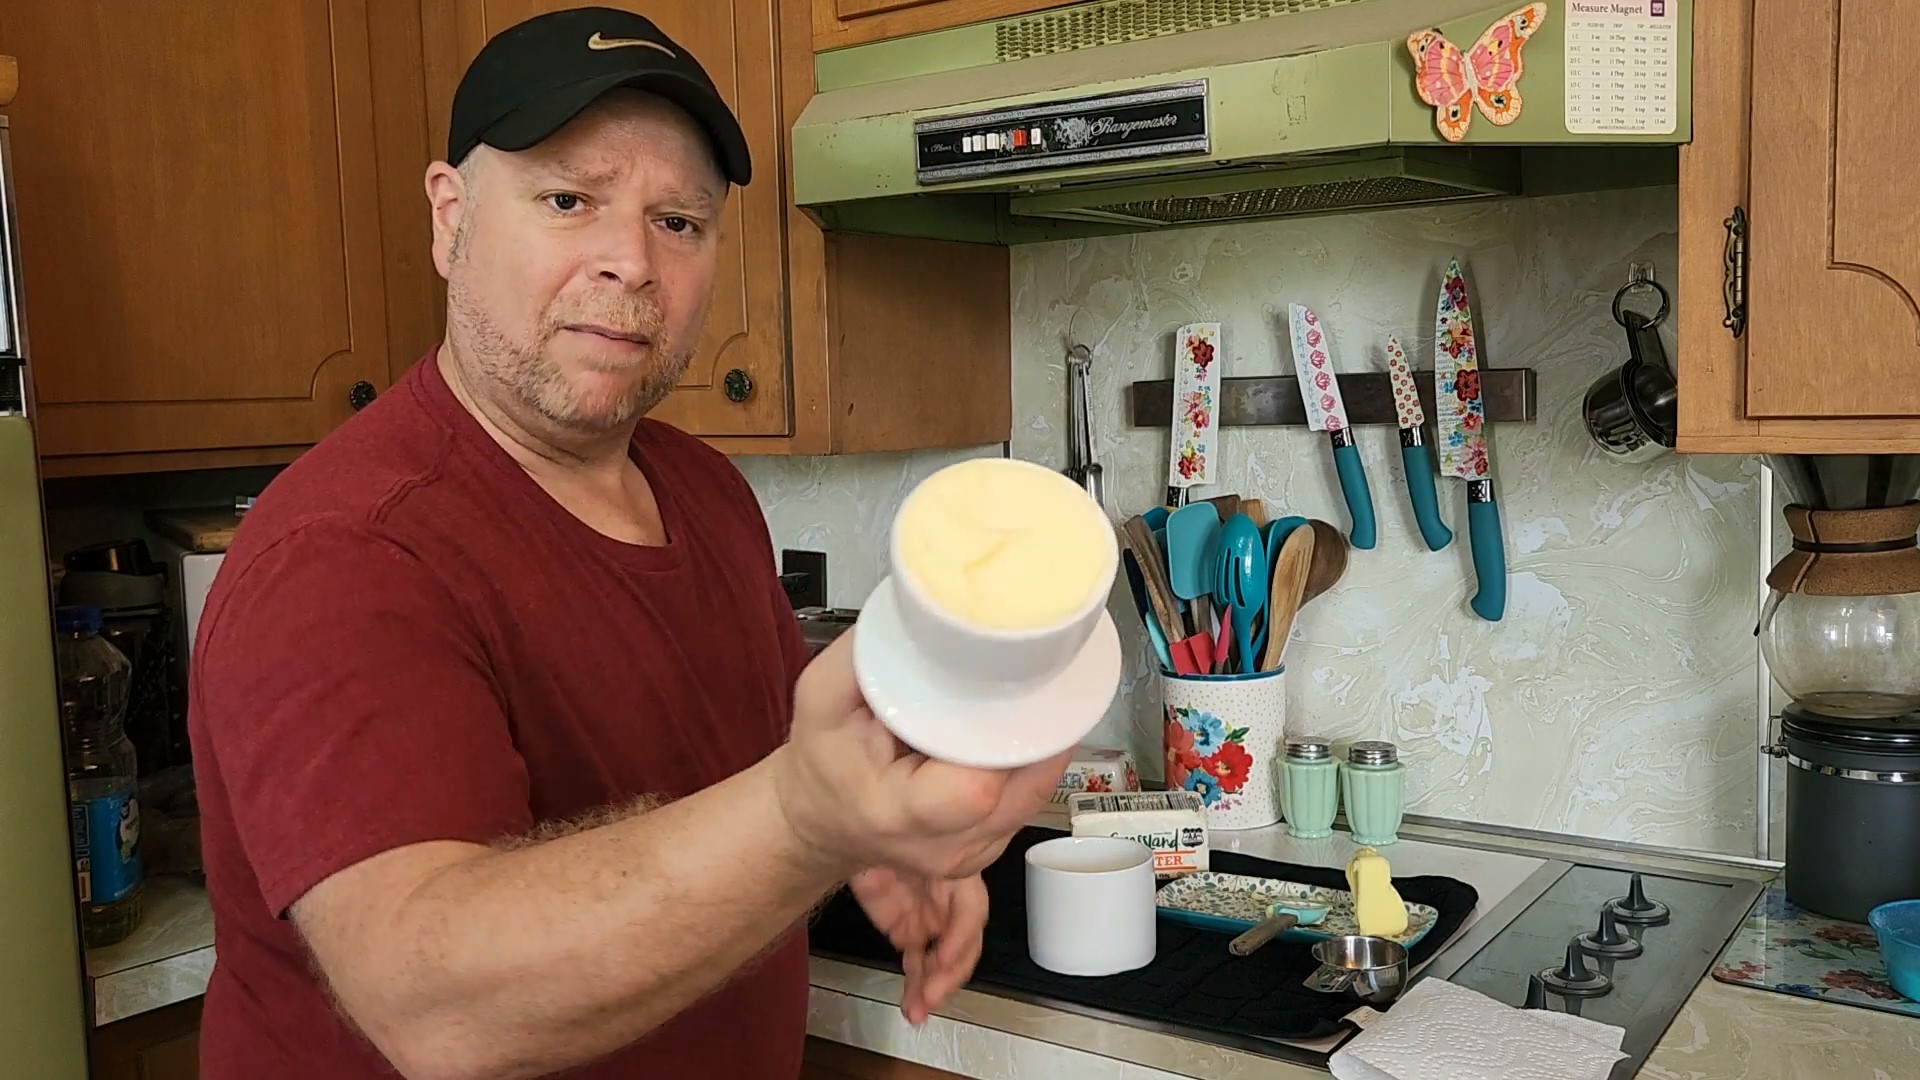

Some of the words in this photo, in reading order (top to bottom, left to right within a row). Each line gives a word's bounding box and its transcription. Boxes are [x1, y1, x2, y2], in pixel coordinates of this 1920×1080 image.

[1572, 2, 1609, 13] Measure
[1610, 3, 1643, 17] Magnet
[1091, 113, 1178, 139] Rangemaster
[1110, 828, 1178, 852] ssland
[1155, 855, 1183, 866] TER
